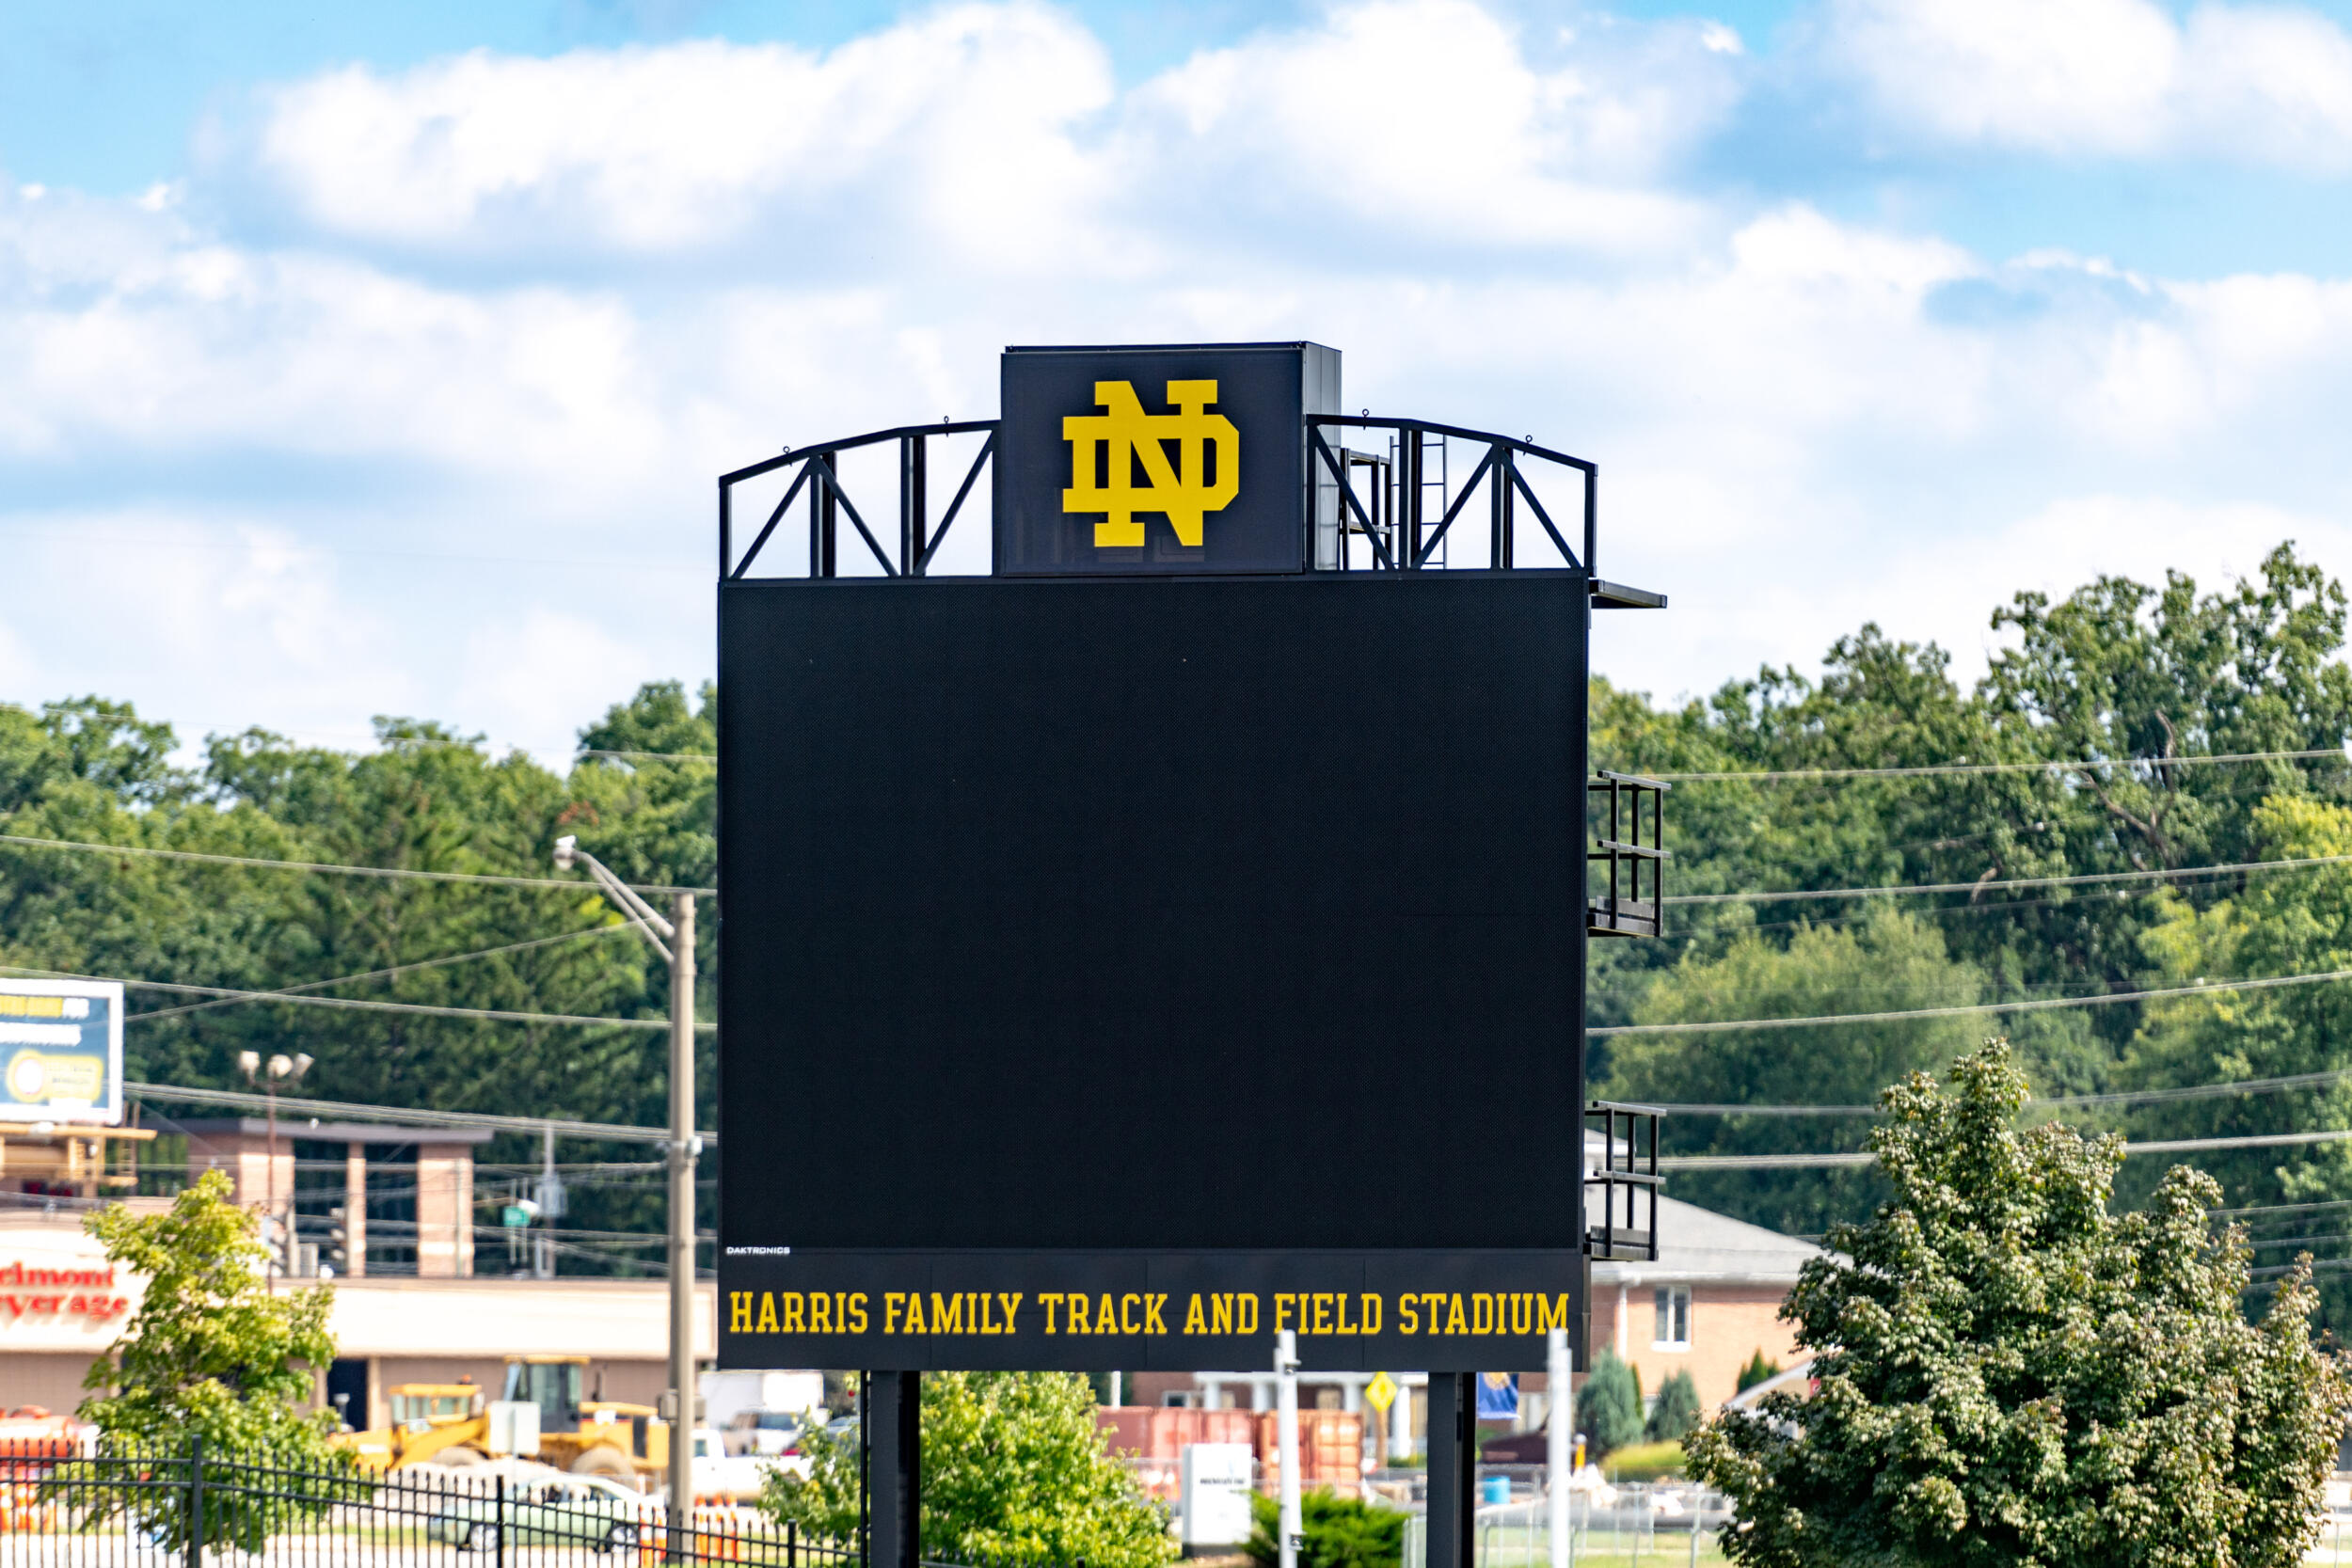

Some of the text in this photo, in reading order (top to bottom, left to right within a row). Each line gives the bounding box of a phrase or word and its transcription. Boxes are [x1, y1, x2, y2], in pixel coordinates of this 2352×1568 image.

[725, 1246, 791, 1256] DAKTRONICS
[729, 1291, 1569, 1336] HARRIS FAMILY TRACK AND FIELD STADIUM
